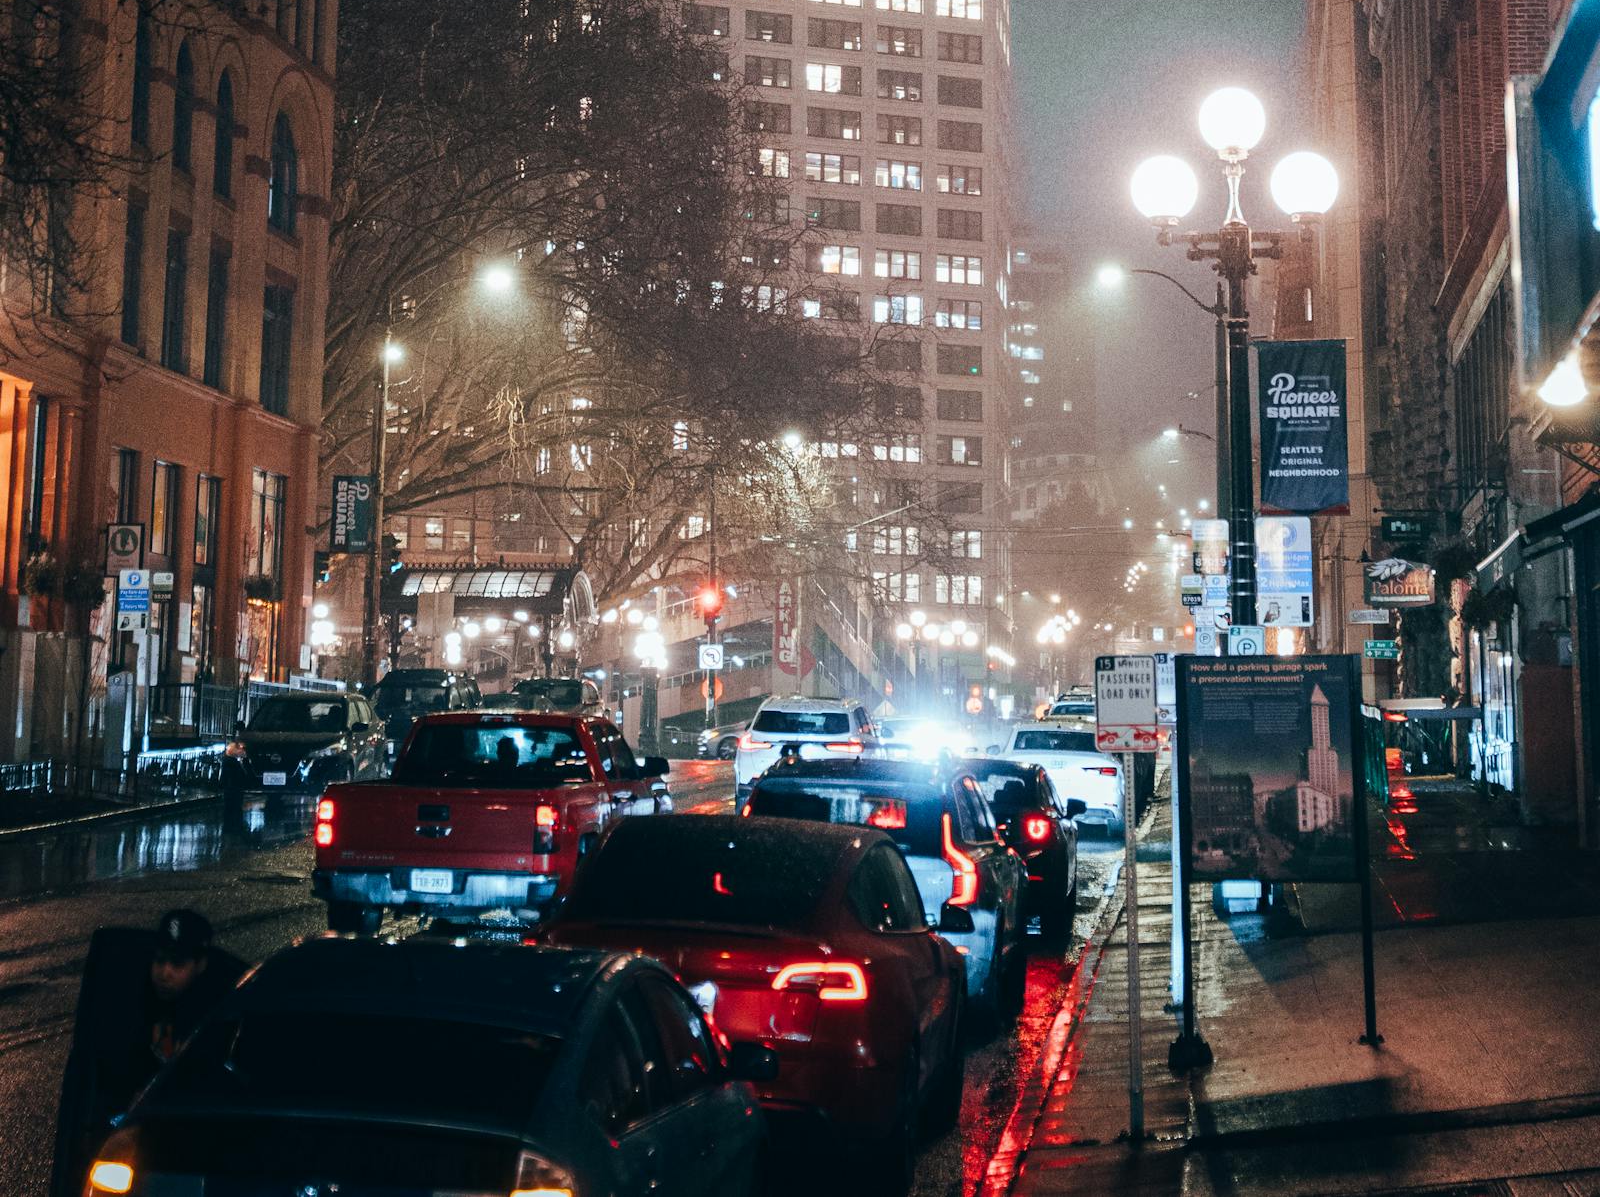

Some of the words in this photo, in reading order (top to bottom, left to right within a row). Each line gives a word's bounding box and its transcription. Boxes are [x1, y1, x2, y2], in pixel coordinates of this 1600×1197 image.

[1267, 373, 1338, 404] Pioneer
[1267, 406, 1340, 419] SQUARE
[1281, 446, 1323, 454] SEATTLE'S
[1269, 469, 1340, 478] NEIGHBORHOOD
[347, 481, 369, 531] Pioneer
[335, 481, 348, 545] SQUARE
[1261, 577, 1267, 587] 2
[1372, 581, 1429, 596] Paloma
[1100, 658, 1111, 669] 15
[1190, 663, 1210, 671] How
[1213, 663, 1227, 671] did
[1237, 663, 1270, 673] parking
[1272, 664, 1301, 673] garage
[1304, 663, 1328, 672] spark
[1100, 673, 1151, 684] PASSENGER
[1198, 675, 1252, 684] preservation
[1254, 674, 1304, 683] movement?
[1101, 688, 1124, 699] LOAD
[1129, 688, 1150, 699] ONLY
